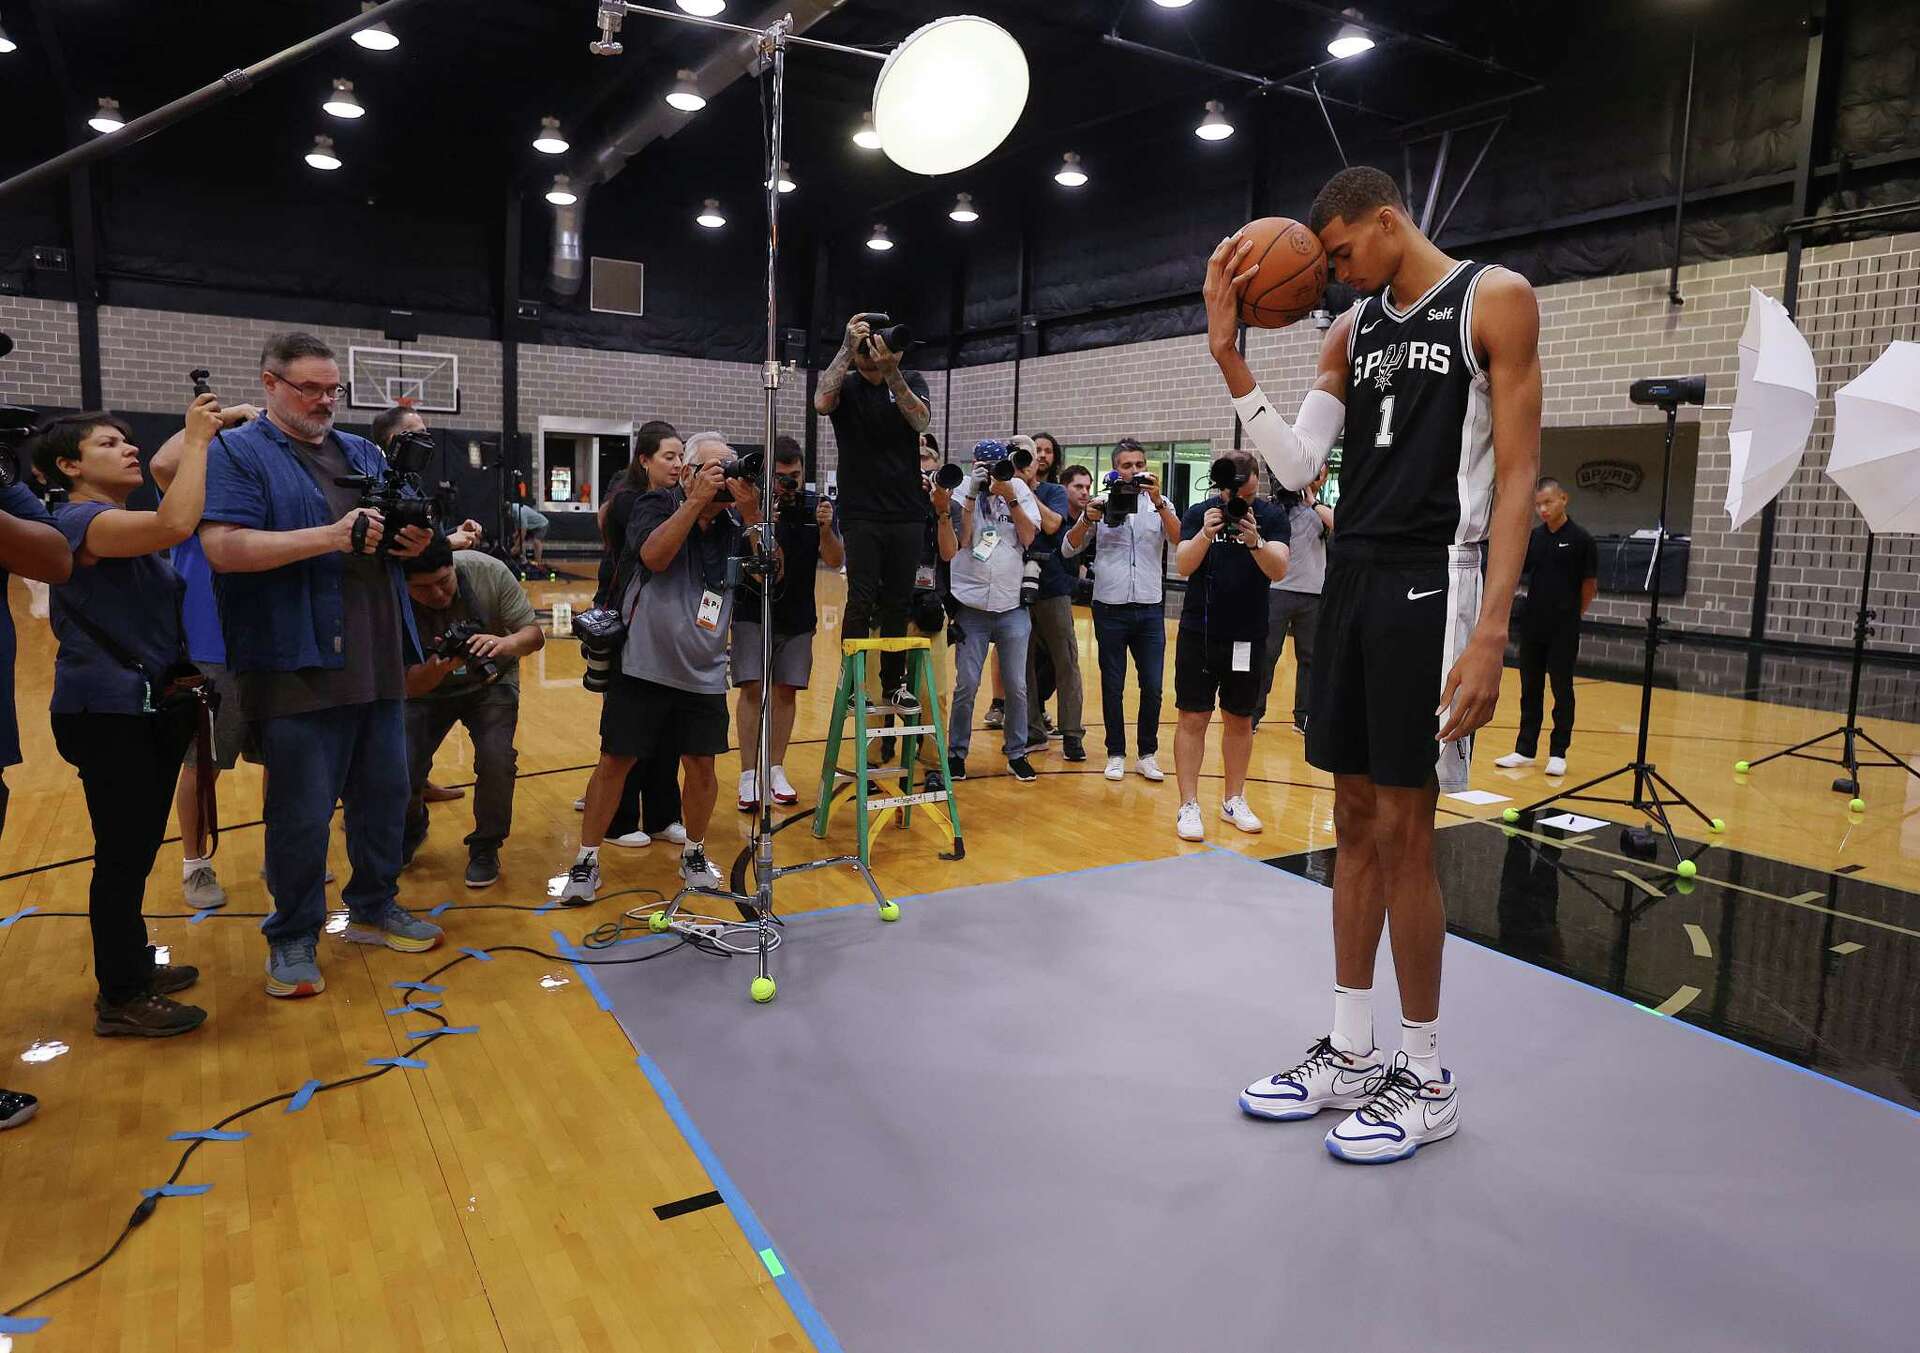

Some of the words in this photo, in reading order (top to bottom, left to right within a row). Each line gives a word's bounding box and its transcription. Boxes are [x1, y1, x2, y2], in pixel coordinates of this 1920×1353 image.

[1427, 307, 1454, 321] Self.
[1353, 341, 1451, 389] SPURS
[1374, 395, 1396, 448] 1
[1582, 468, 1634, 484] SPURS
